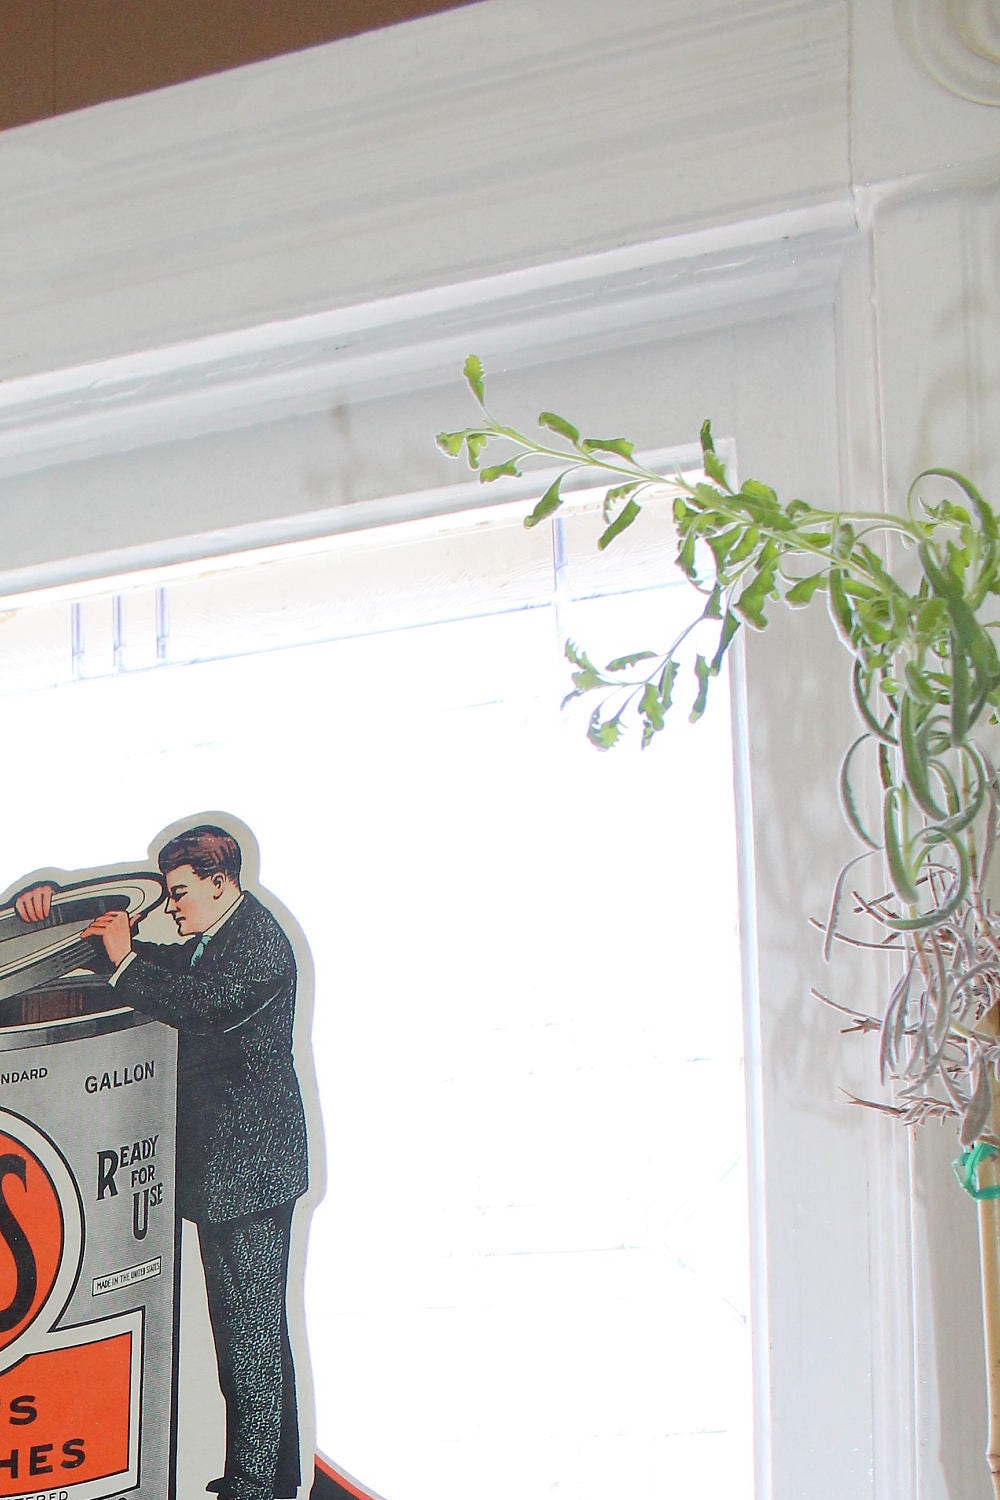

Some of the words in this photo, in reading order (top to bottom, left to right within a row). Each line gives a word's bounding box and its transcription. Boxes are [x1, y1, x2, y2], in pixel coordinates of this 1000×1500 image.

[84, 1060, 155, 1094] GALLON
[96, 1135, 160, 1201] READY
[131, 1164, 155, 1189] FOR
[132, 1182, 164, 1241] USE
